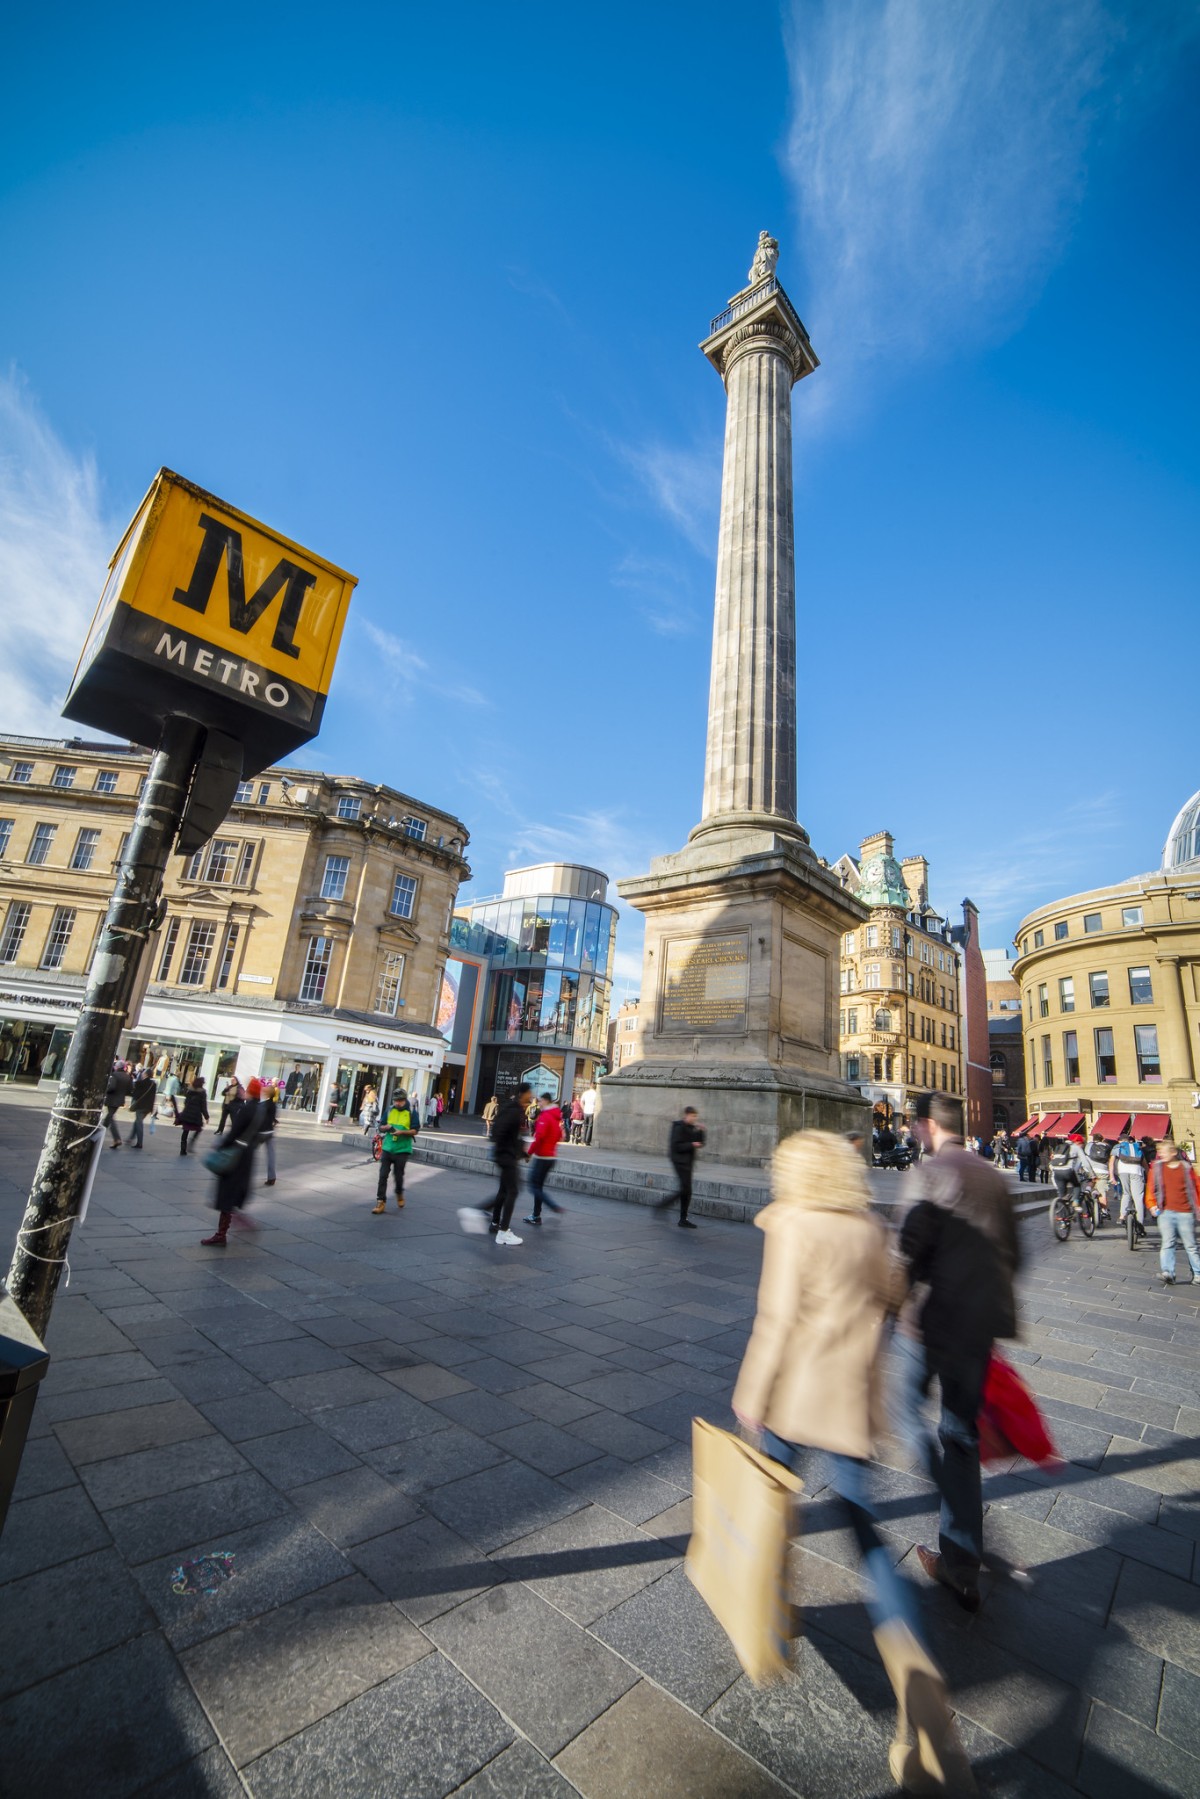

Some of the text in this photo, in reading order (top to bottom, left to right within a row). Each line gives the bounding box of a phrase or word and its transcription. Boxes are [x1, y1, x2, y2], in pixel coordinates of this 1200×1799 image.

[172, 511, 317, 660] M
[154, 633, 290, 708] METRO
[20, 994, 83, 1008] CONNECTIO
[336, 1034, 434, 1057] FRENCH CONNECTION
[260, 1077, 286, 1089] sae
